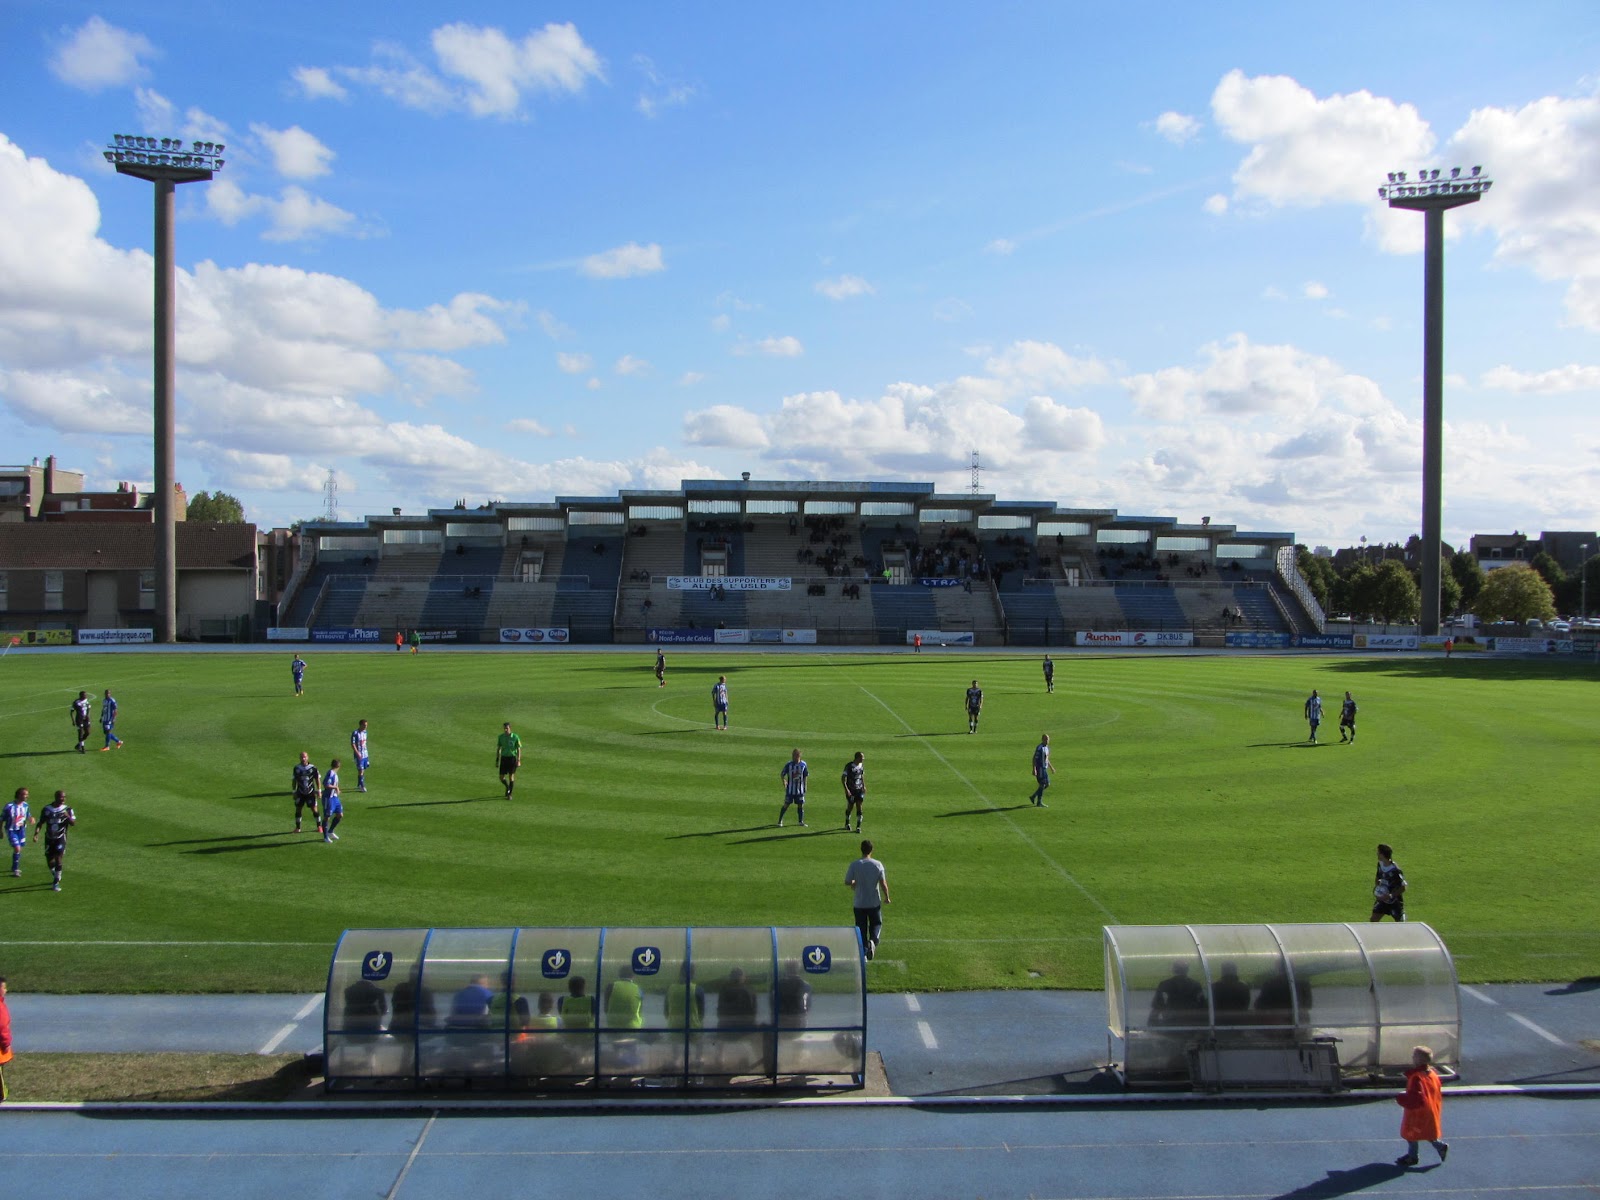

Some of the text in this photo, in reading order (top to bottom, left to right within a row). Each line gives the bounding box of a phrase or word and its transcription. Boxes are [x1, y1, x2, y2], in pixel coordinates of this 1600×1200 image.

[79, 630, 152, 642] www.usldunkerque.com
[354, 628, 380, 639] Phare
[1084, 632, 1122, 641] Auchan
[1302, 637, 1351, 645] Domino's Pizza
